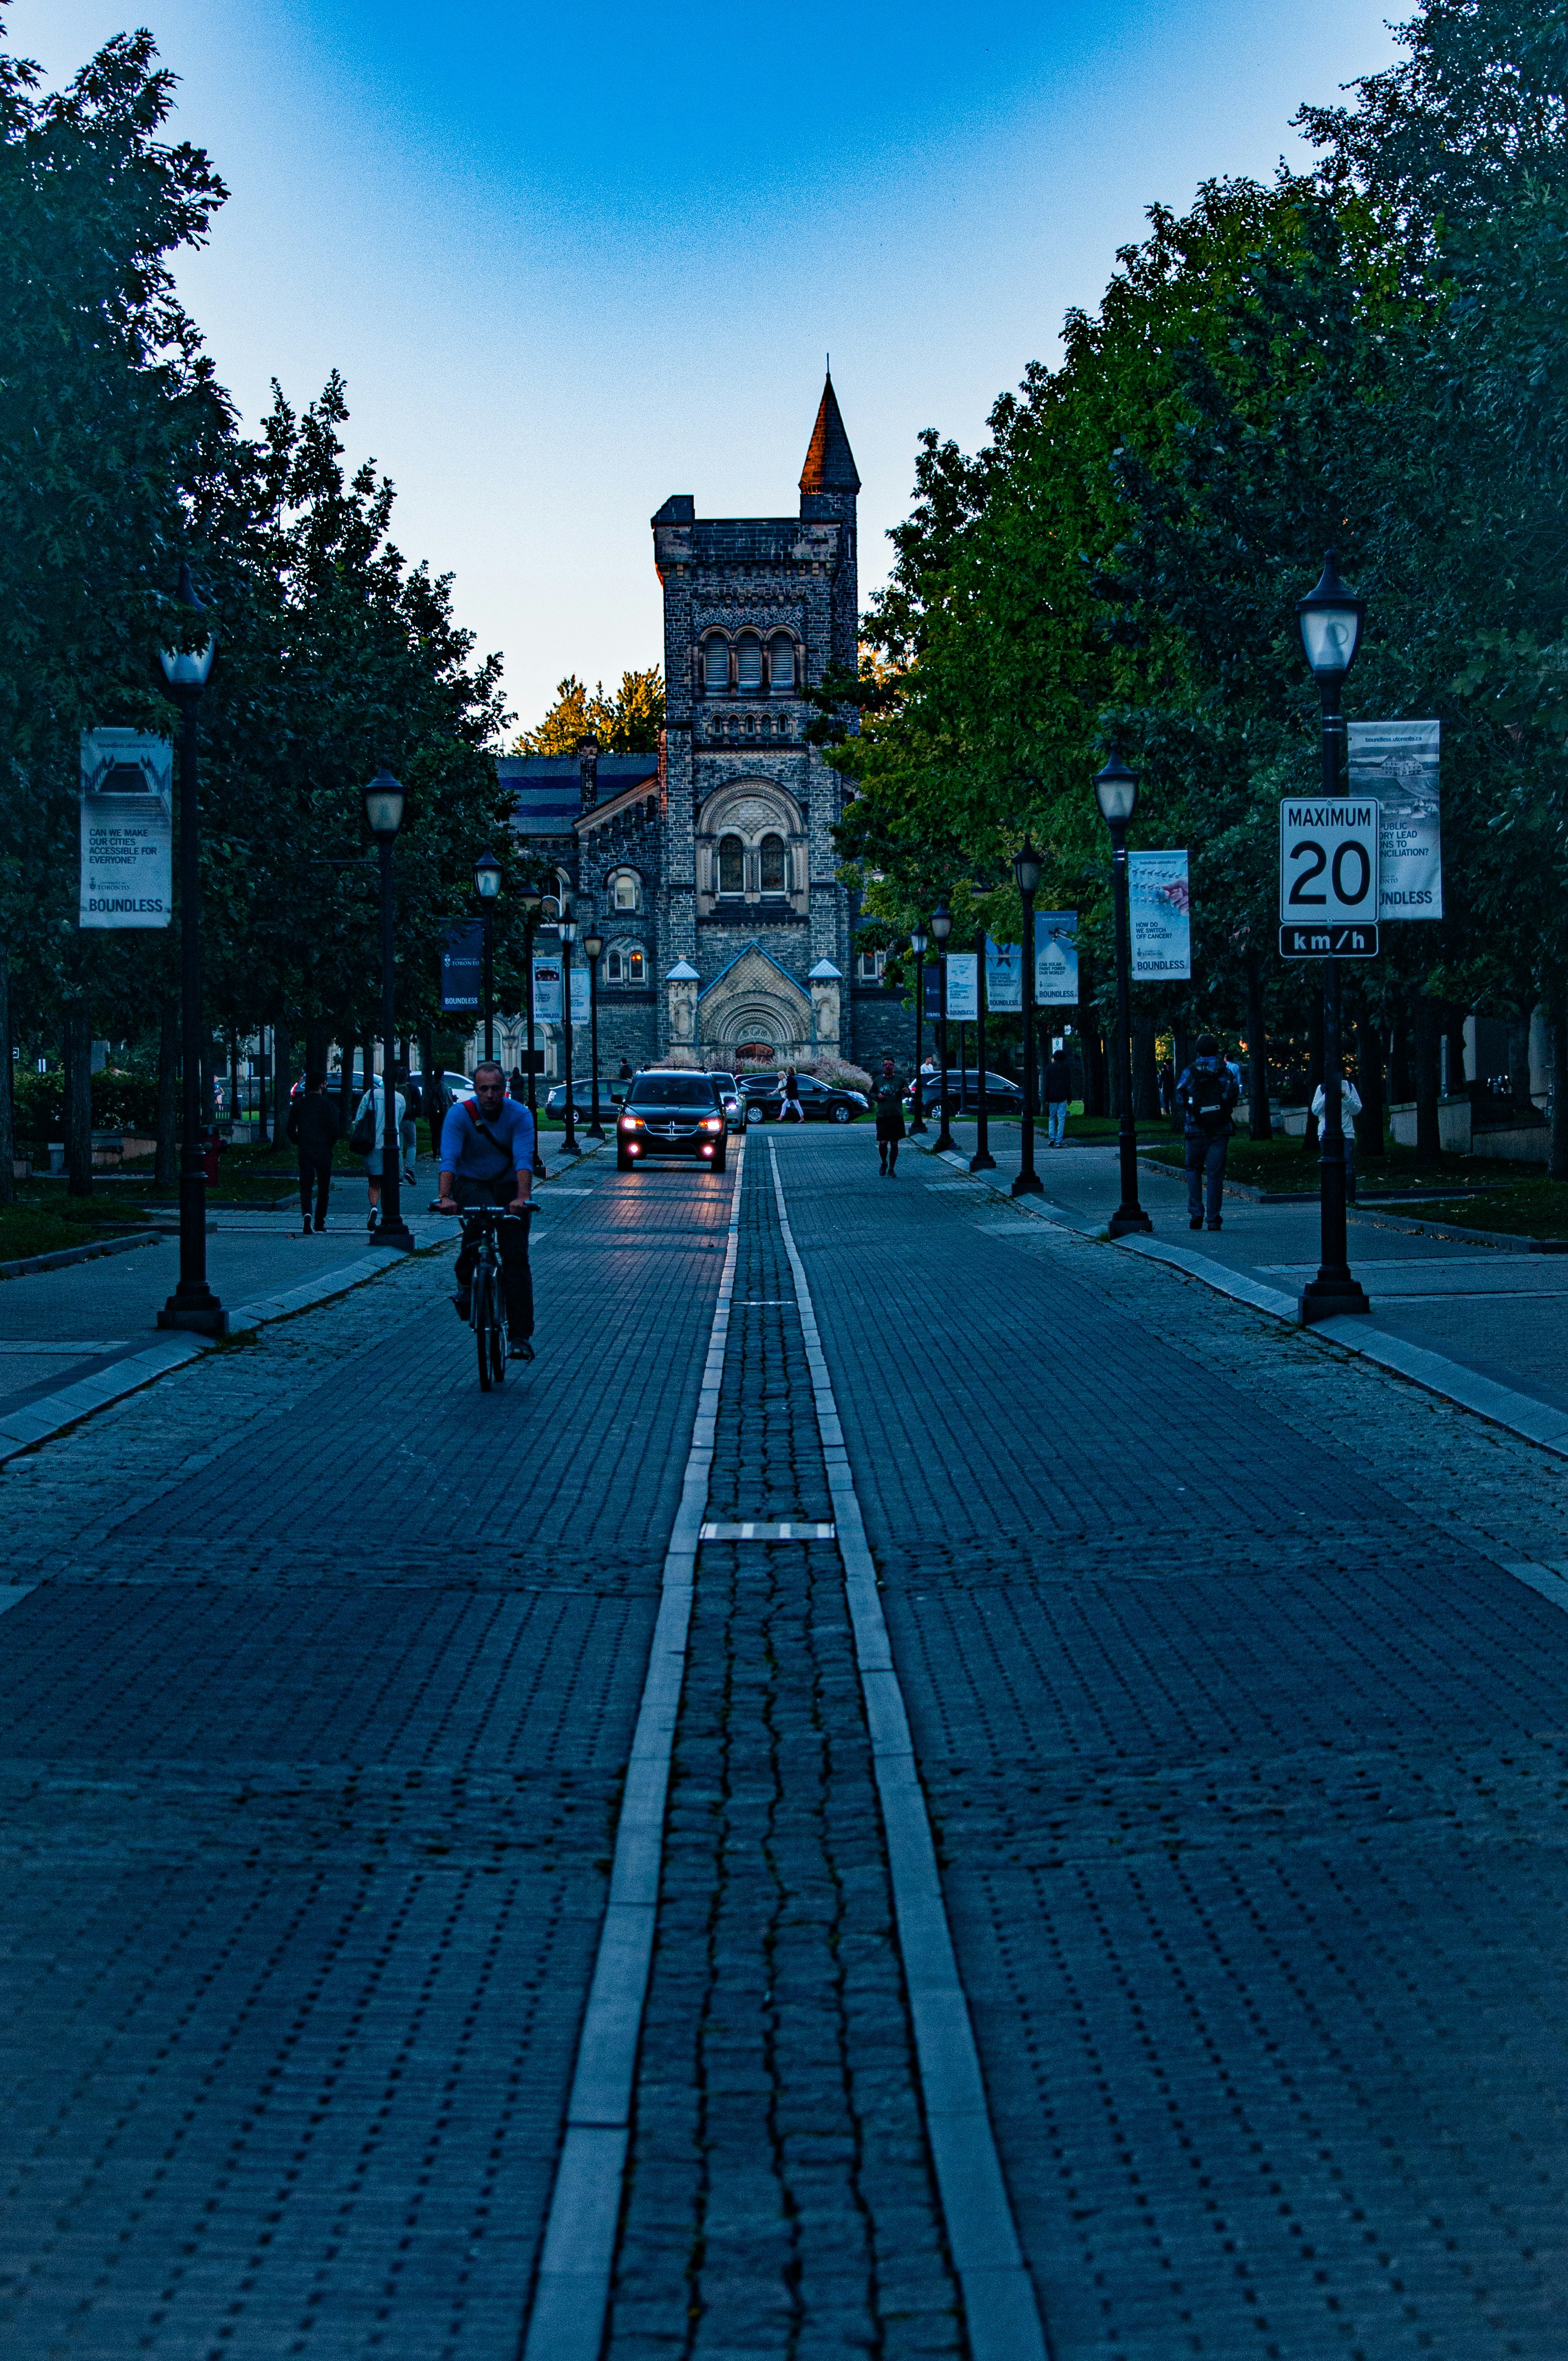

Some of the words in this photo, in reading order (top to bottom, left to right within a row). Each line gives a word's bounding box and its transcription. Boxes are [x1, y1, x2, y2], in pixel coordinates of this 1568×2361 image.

[1288, 808, 1371, 826] MAXIMUM
[89, 829, 107, 837] CAN
[124, 829, 149, 837] MAKE
[1396, 830, 1417, 839] LEAD
[89, 847, 139, 855] ACCESSIBLE
[1288, 840, 1370, 906] 20
[89, 899, 162, 912] BOUNDLESS
[1294, 931, 1364, 950] km/h
[1137, 960, 1185, 970] BOUNDLESS
